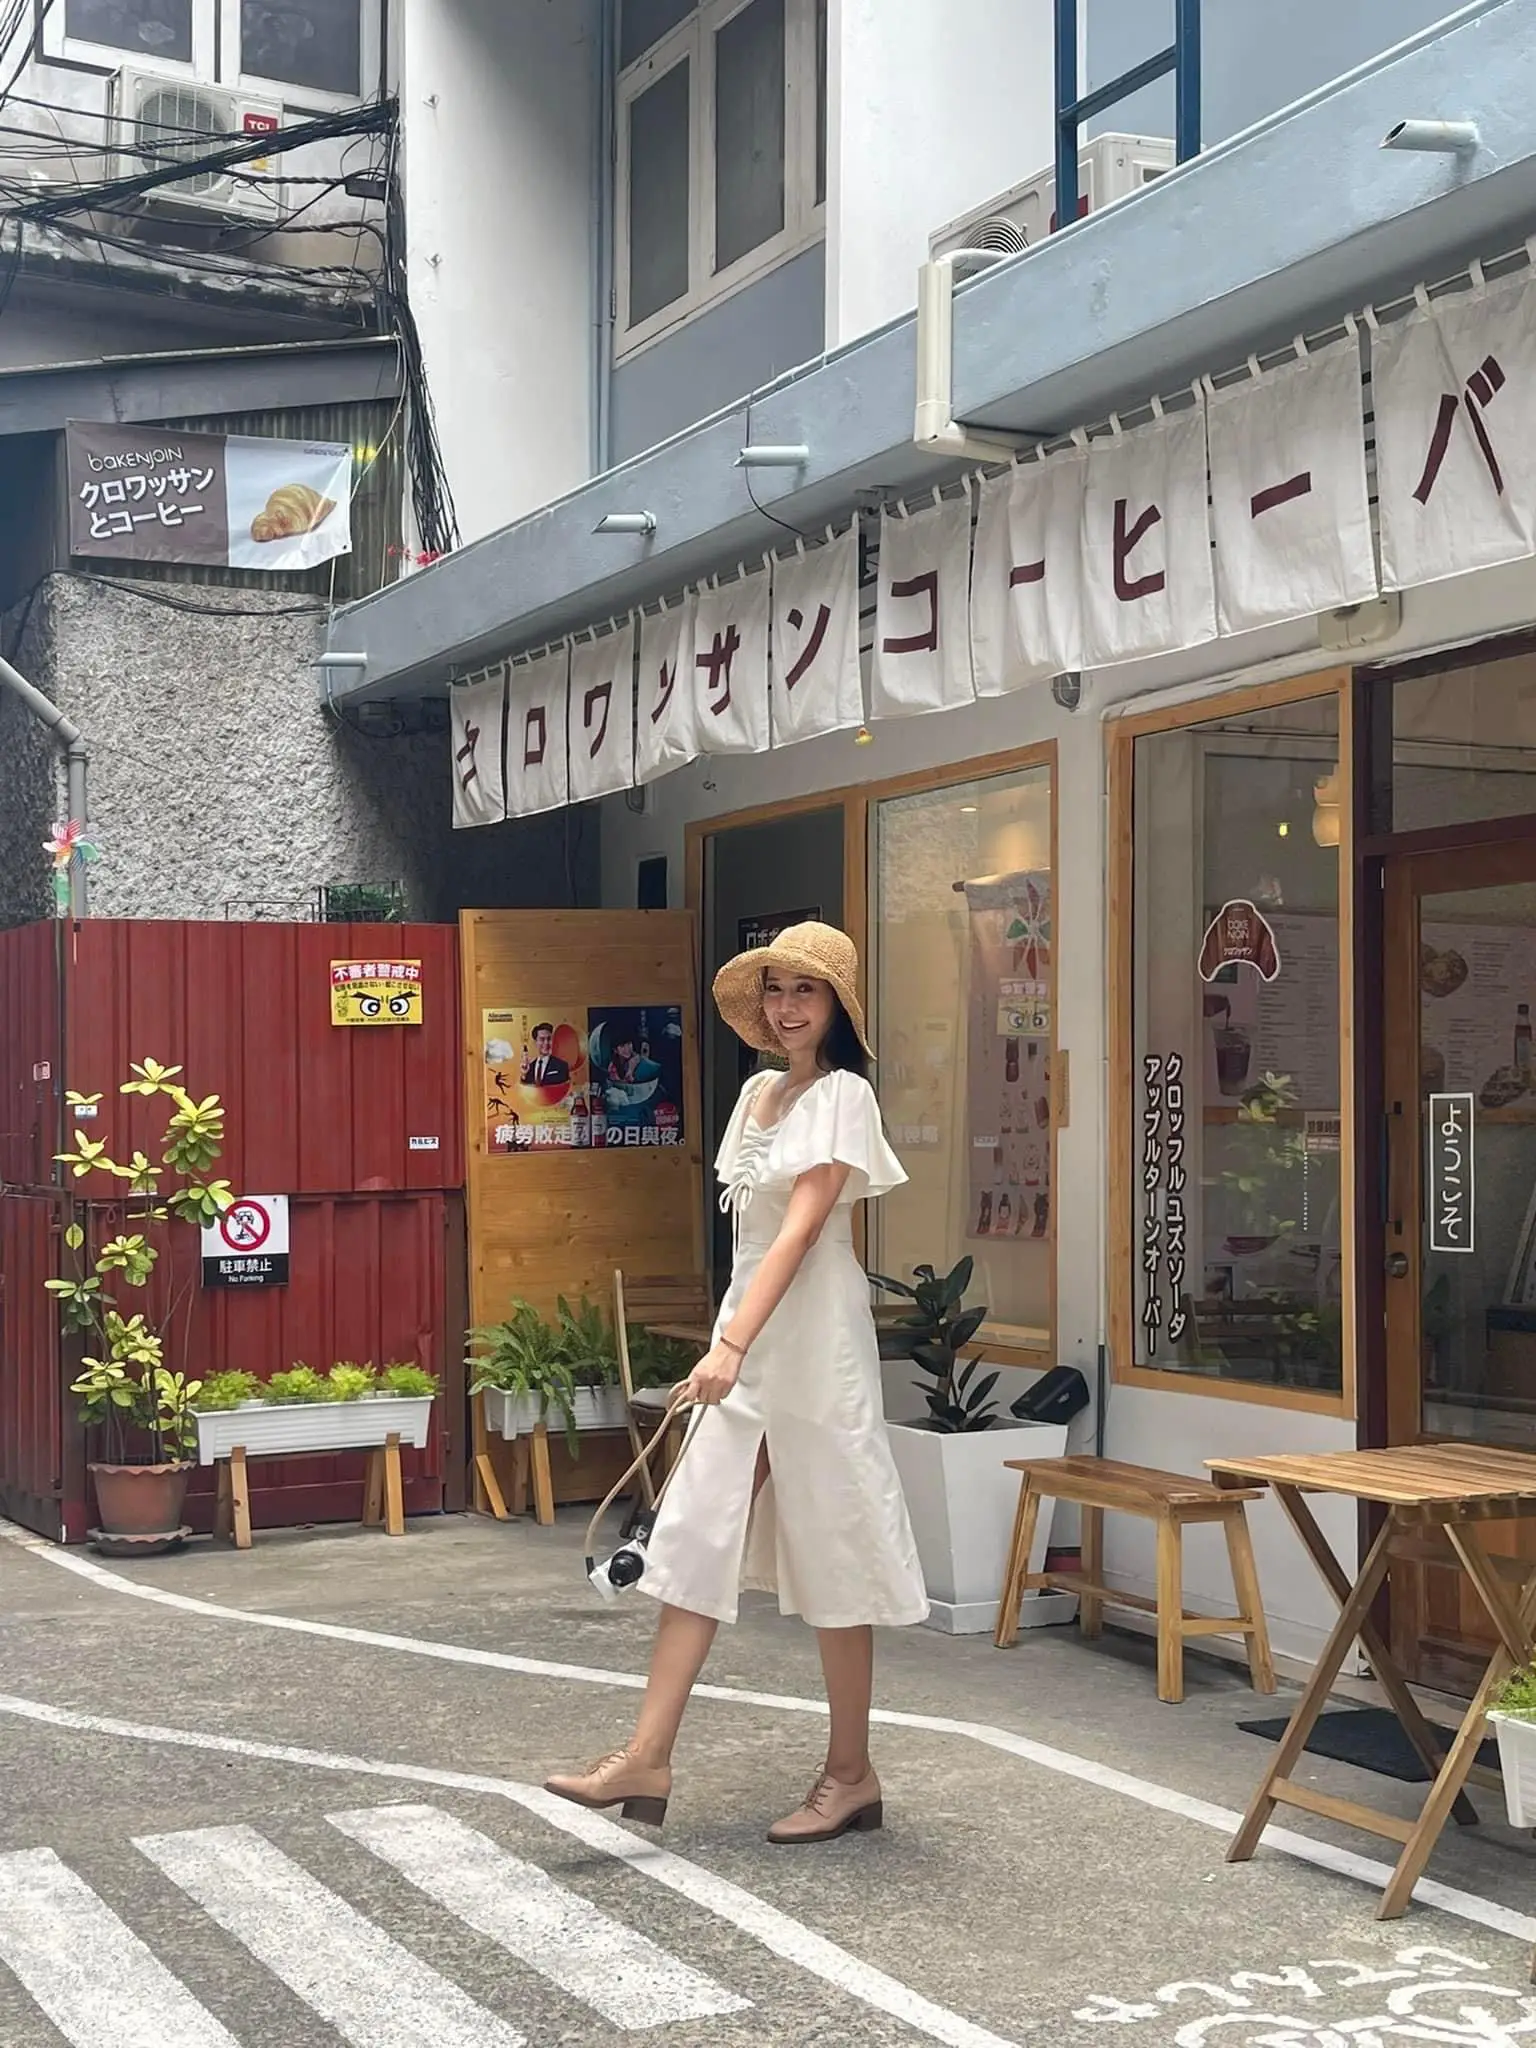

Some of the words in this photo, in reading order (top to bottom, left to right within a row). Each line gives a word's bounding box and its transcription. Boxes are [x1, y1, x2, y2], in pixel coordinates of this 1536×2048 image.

[79, 466, 215, 509] クロワッサン
[88, 501, 204, 539] とコーヒー
[1440, 1103, 1463, 1240] ようこそ
[219, 1258, 273, 1274] 駐車禁止
